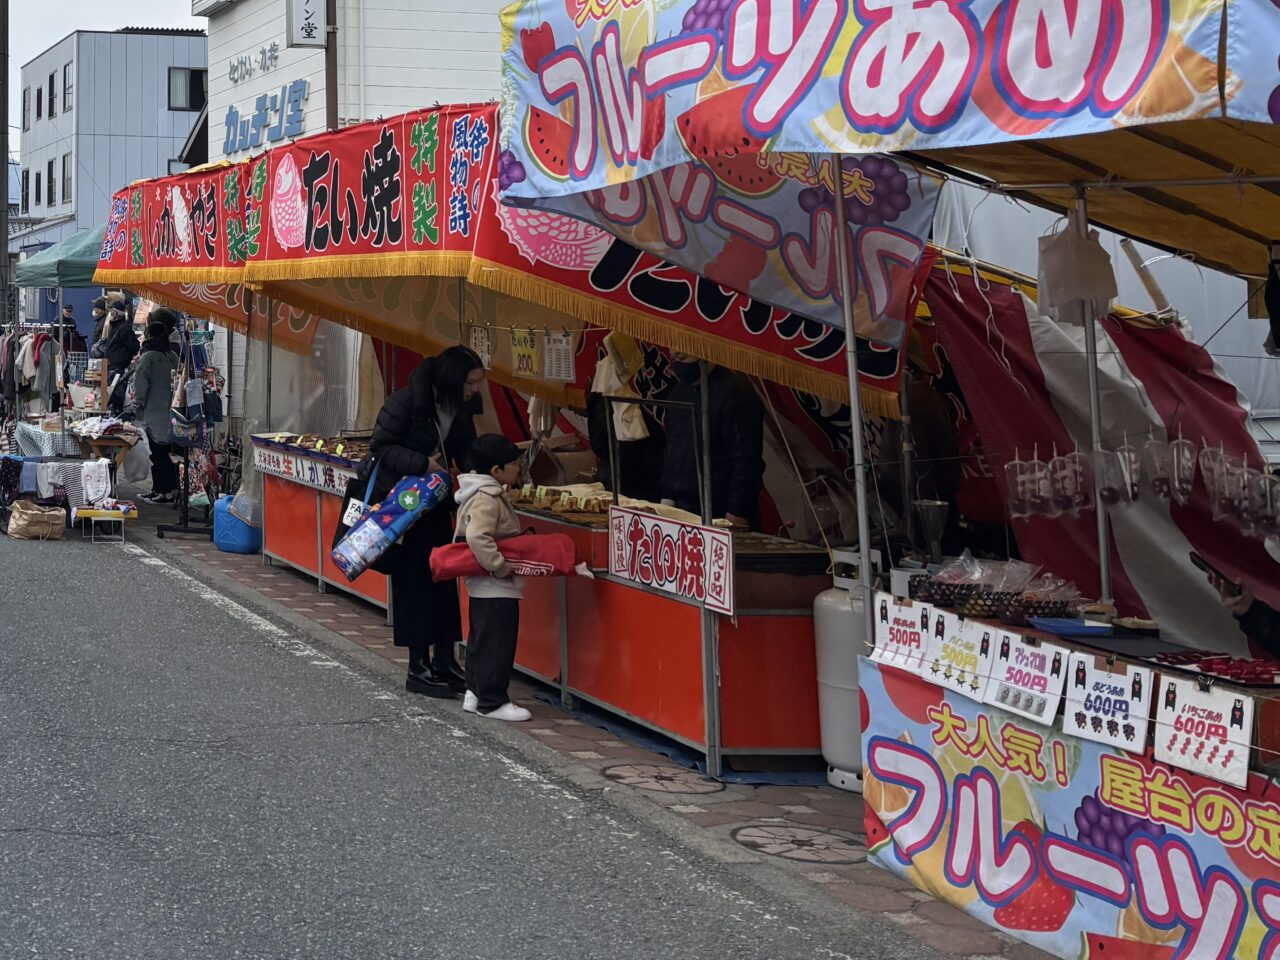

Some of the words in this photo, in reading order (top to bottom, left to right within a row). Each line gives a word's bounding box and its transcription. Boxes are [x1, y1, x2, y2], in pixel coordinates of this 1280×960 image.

[223, 78, 307, 155] カッチン堂
[303, 125, 404, 253] たい焼
[410, 112, 440, 244] 特製
[450, 113, 471, 237] 風物詩
[131, 186, 145, 265] 特製
[224, 169, 247, 262] 特製
[629, 513, 706, 602] たい焼
[711, 544, 726, 599] 絶品
[889, 627, 921, 650] 500円
[940, 643, 978, 674] 500円
[1005, 666, 1048, 693] 500円
[1083, 692, 1130, 721] 600円
[1181, 703, 1223, 722] いちごあめ
[1173, 715, 1228, 745] 600円
